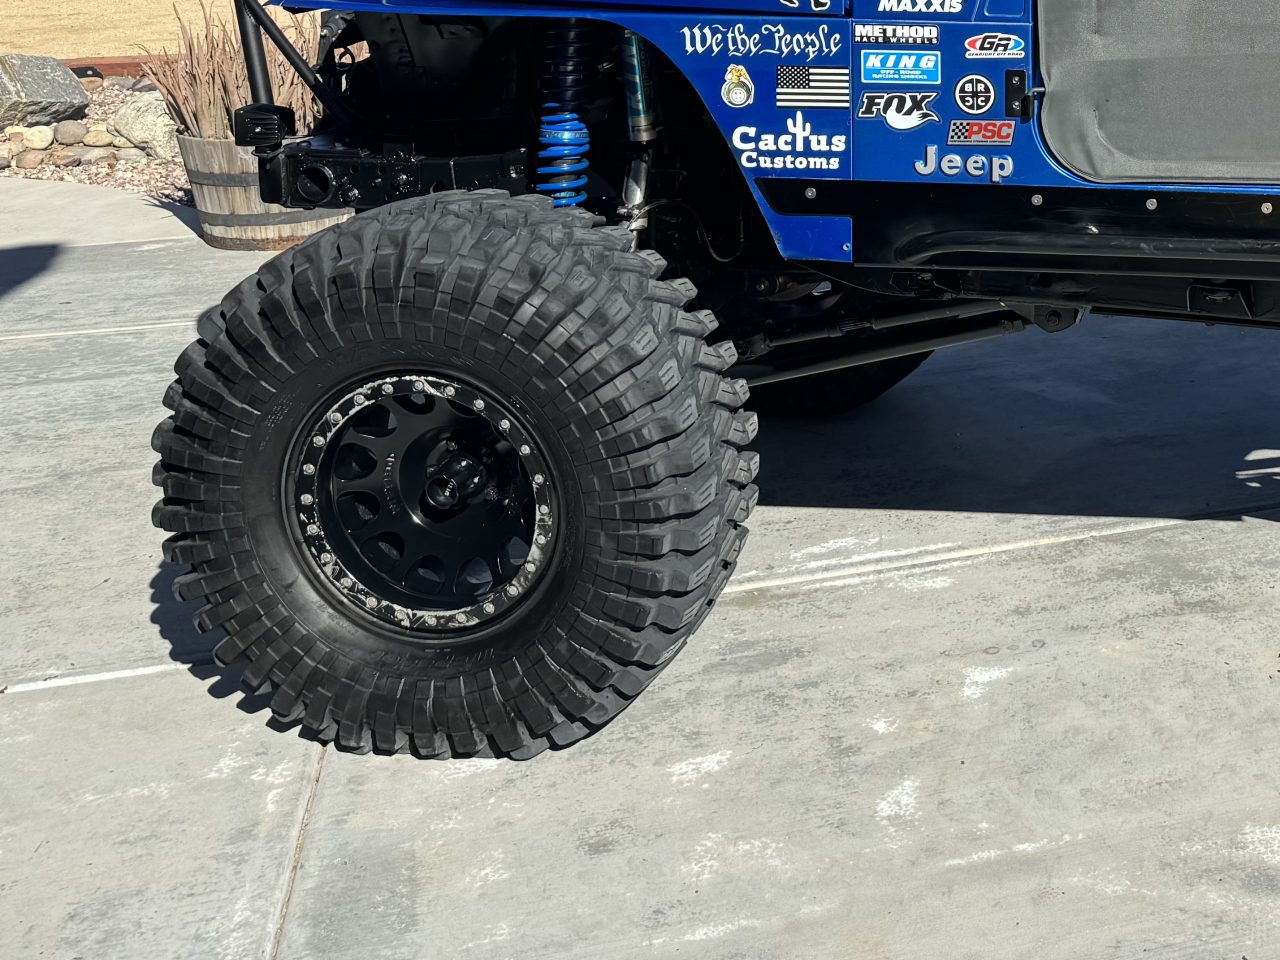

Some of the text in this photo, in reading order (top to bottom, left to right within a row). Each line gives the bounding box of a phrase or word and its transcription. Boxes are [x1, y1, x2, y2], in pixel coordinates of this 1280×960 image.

[854, 24, 938, 38] METHOD
[680, 23, 842, 62] We the People
[889, 37, 938, 45] WHEELS
[865, 54, 937, 69] KING
[859, 93, 938, 118] FOX
[731, 111, 847, 152] Cactus
[966, 122, 1013, 140] PSC
[740, 151, 840, 170] Customs
[914, 144, 1014, 182] Jeep
